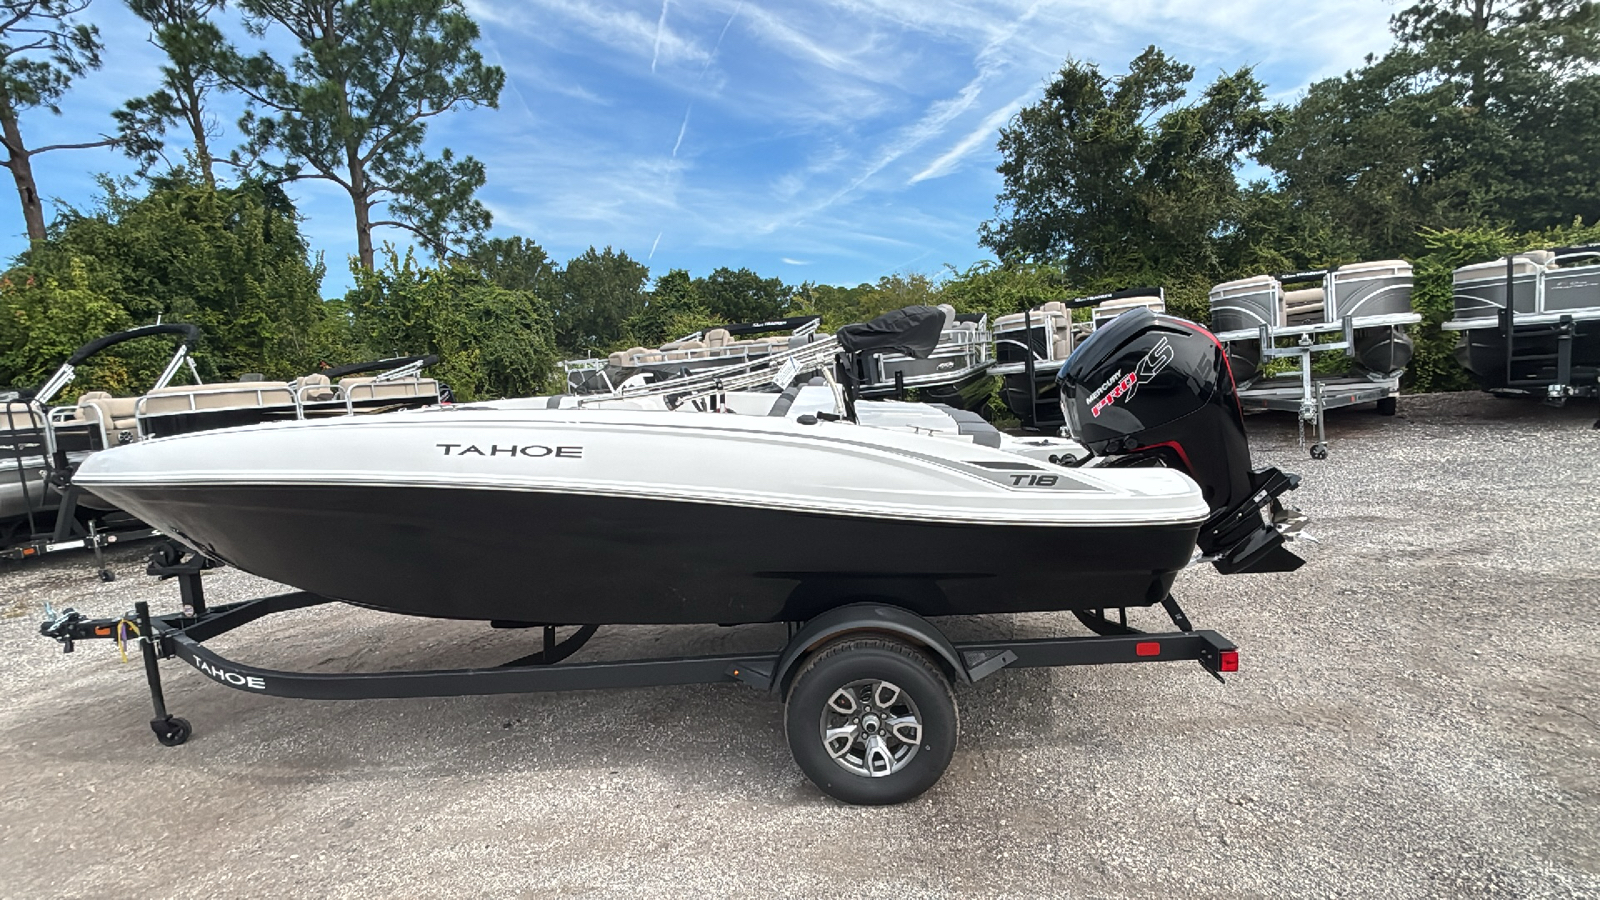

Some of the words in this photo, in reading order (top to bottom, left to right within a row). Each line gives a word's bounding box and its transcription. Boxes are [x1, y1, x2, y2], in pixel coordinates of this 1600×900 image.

[1086, 369, 1122, 405] MERCURY
[1091, 371, 1137, 418] PRO
[1124, 336, 1174, 403] XS
[436, 443, 583, 458] TAHOE
[1009, 474, 1059, 487] T18
[192, 654, 266, 689] TAHOE
